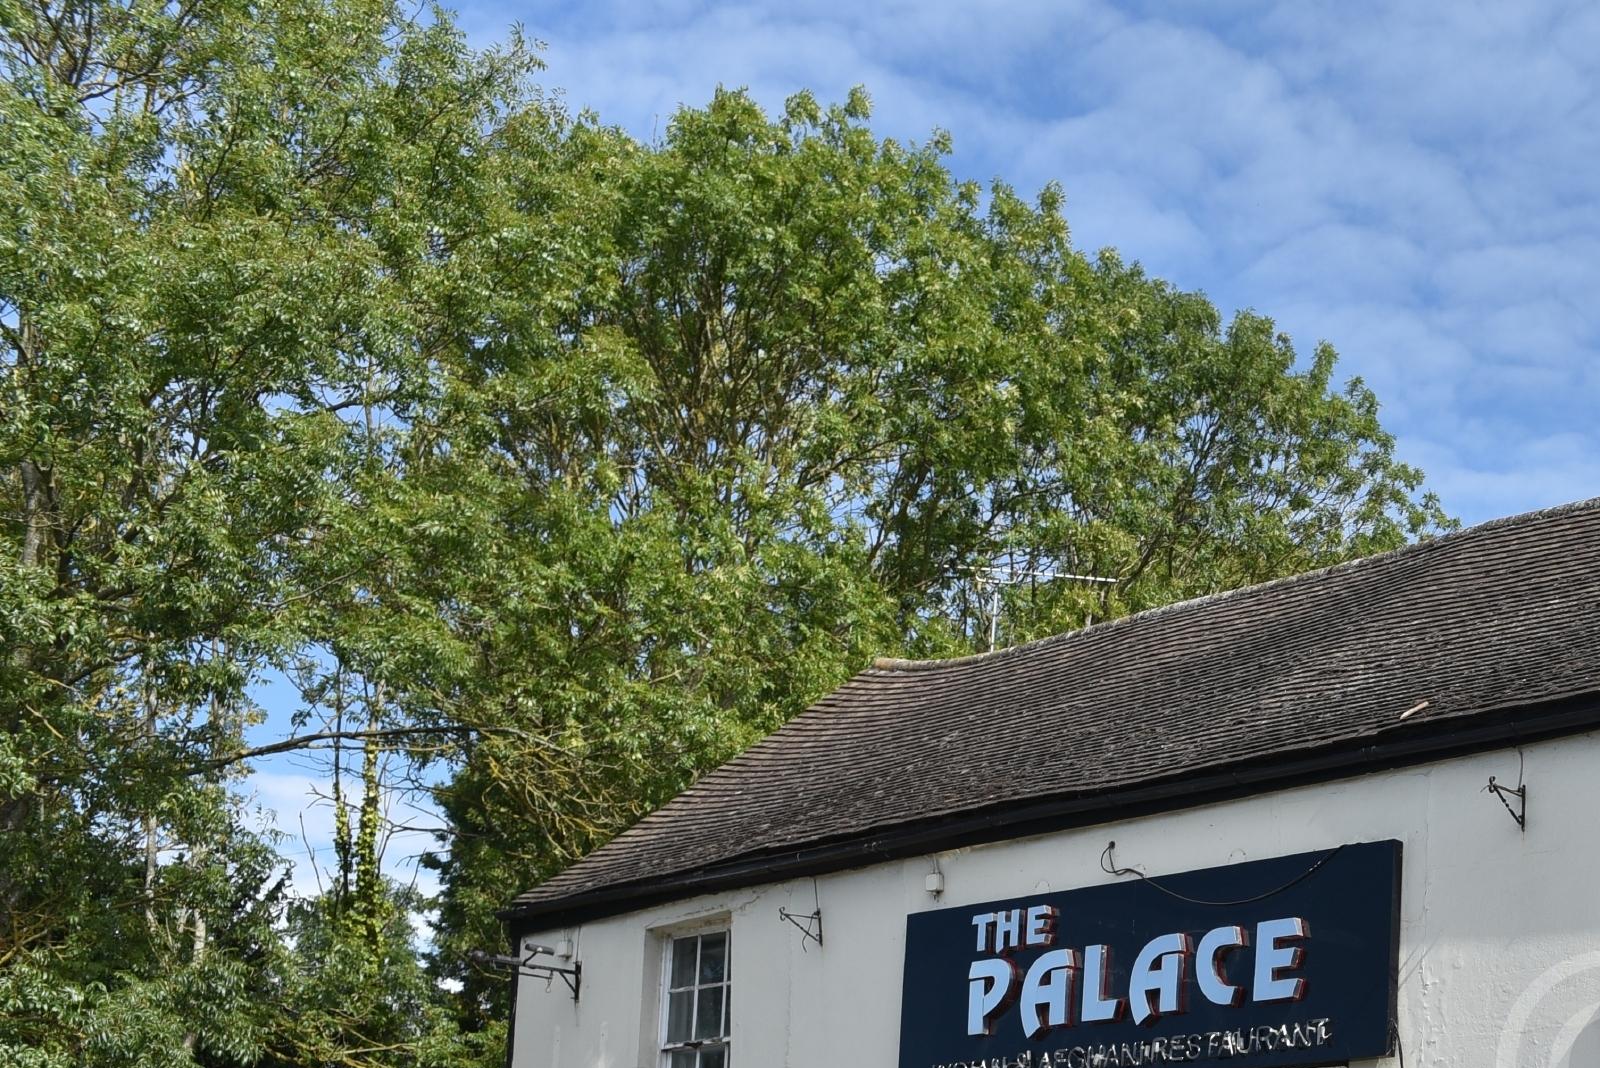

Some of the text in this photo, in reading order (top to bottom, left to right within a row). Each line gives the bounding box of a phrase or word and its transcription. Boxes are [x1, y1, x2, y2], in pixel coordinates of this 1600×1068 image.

[972, 904, 1058, 953] THE
[967, 917, 1308, 1038] PALACE
[1151, 1018, 1332, 1063] RESTAURANT
